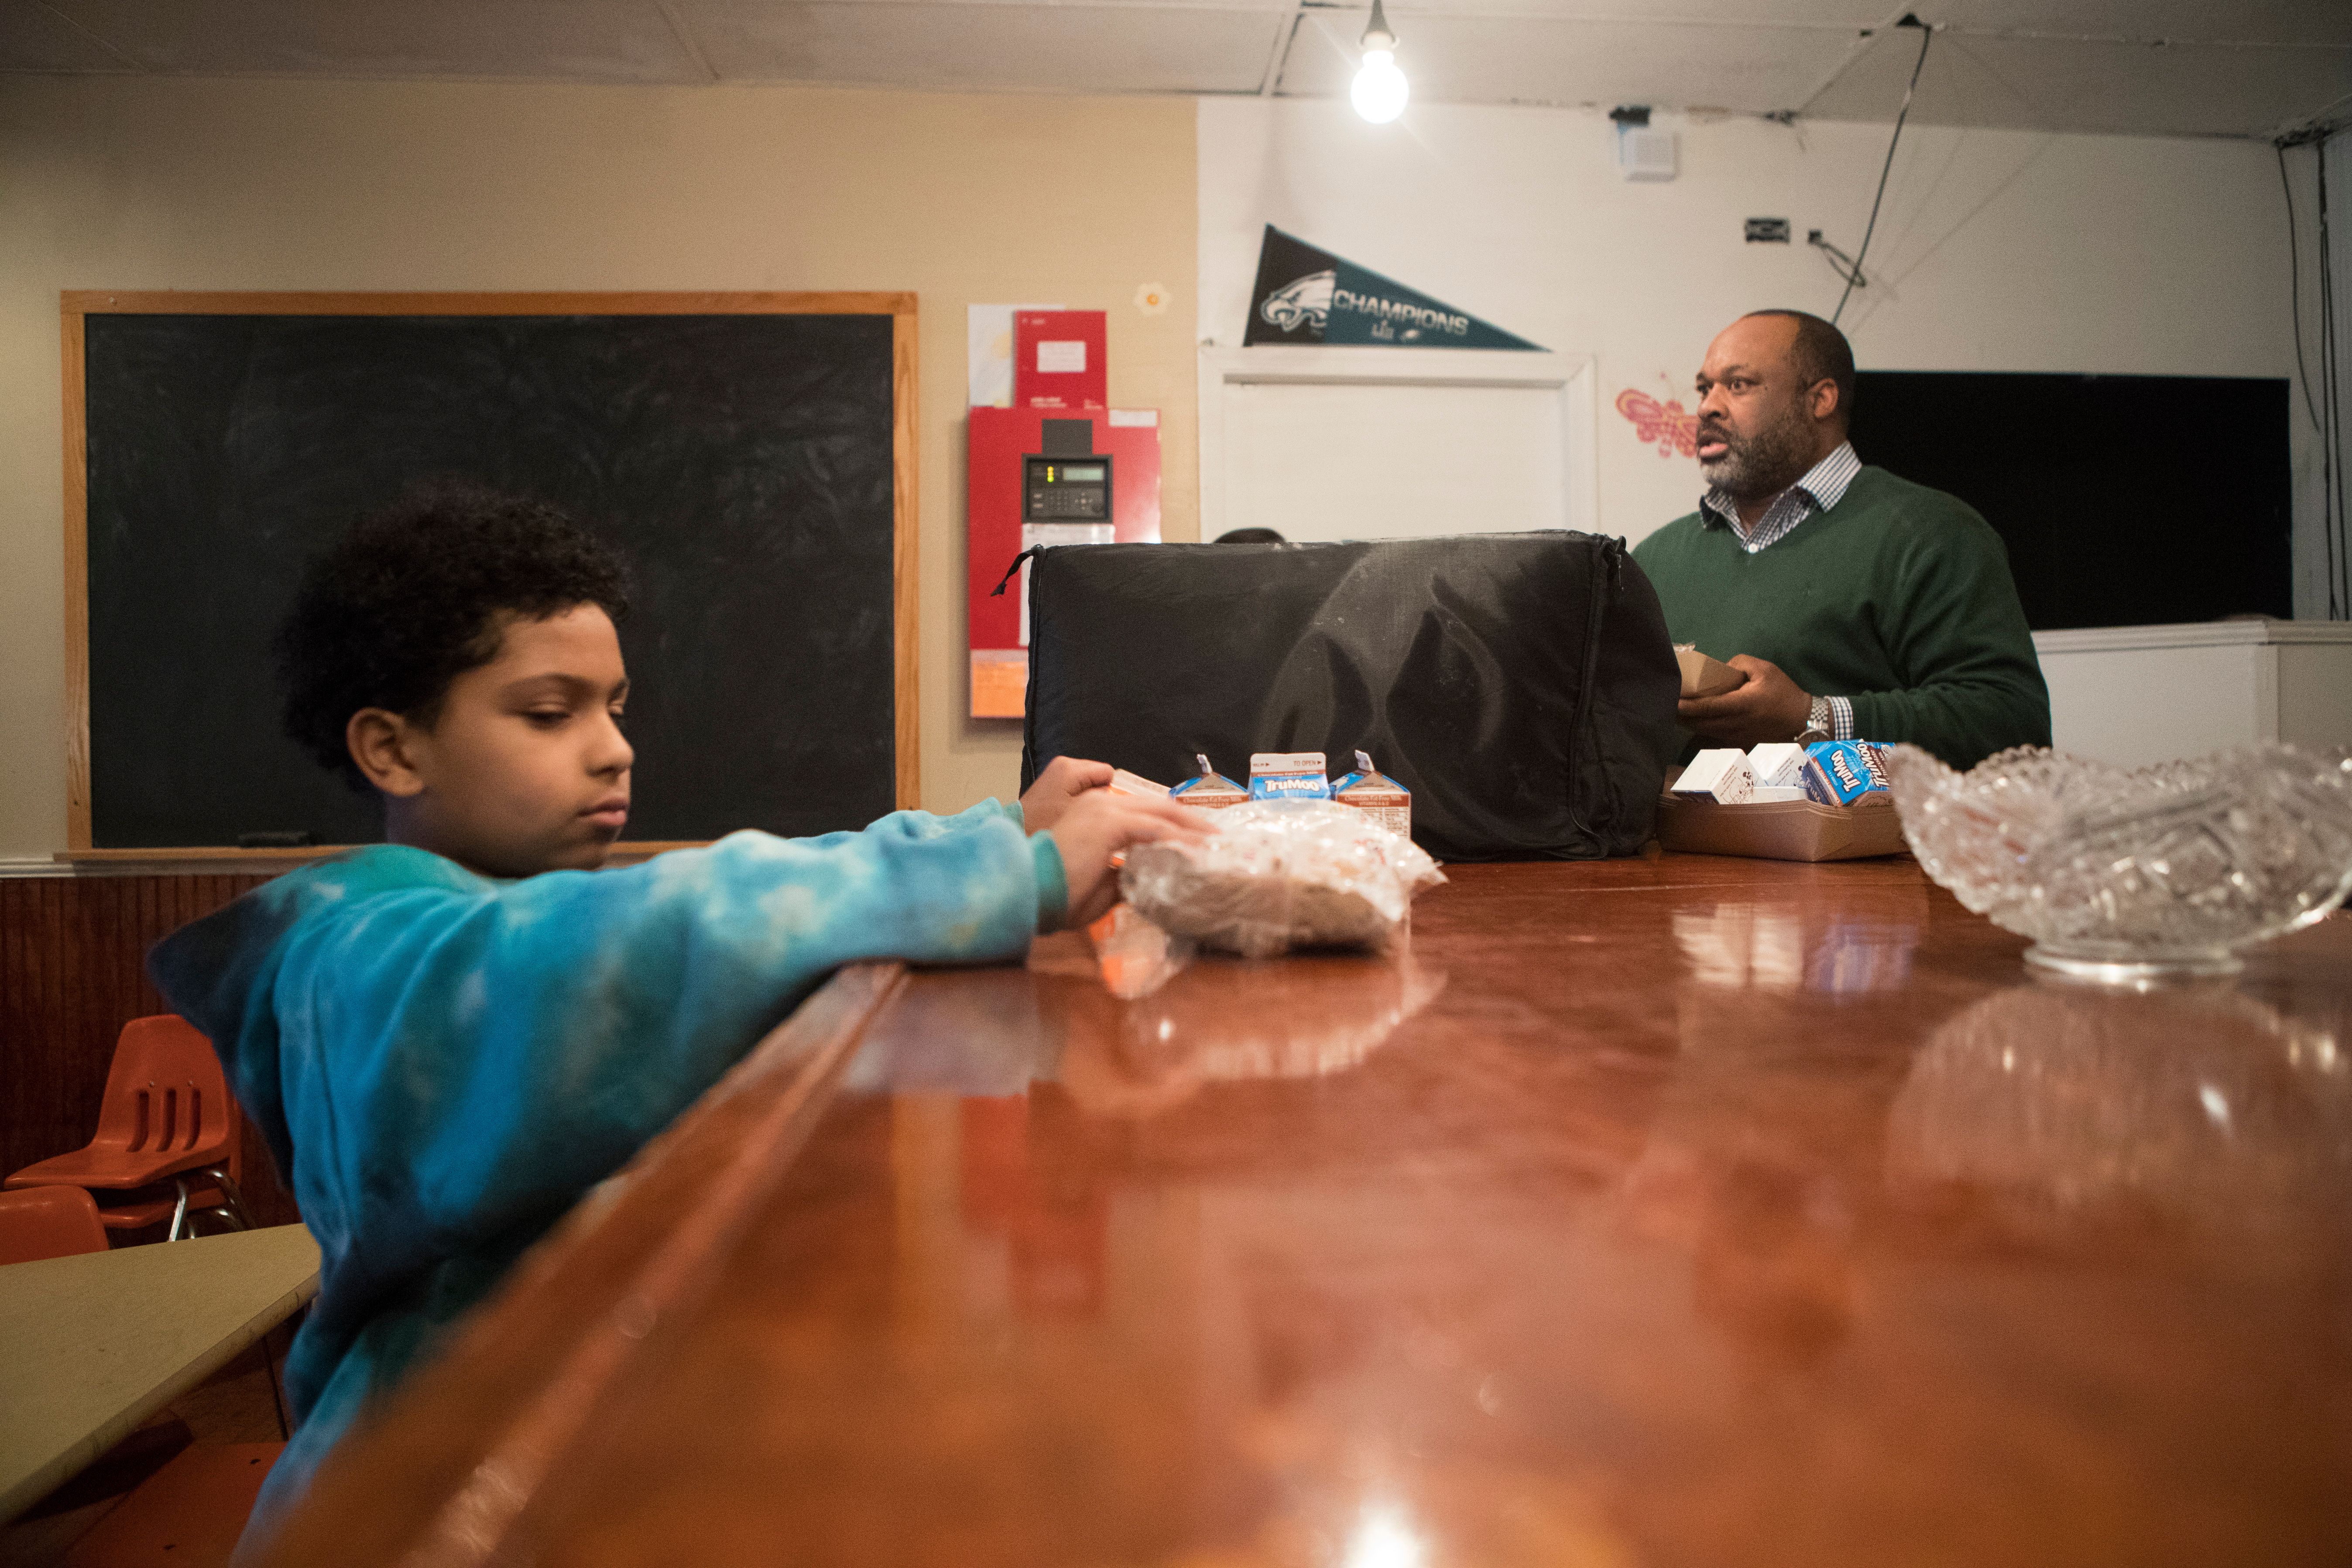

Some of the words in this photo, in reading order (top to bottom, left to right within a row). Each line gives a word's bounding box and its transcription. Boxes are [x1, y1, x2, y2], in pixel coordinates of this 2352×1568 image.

[1334, 290, 1468, 335] CHAMPIONS
[1265, 779, 1320, 792] TruMoo
[1831, 750, 1861, 792] TruMoo
[1857, 743, 1890, 787] TruMoo
